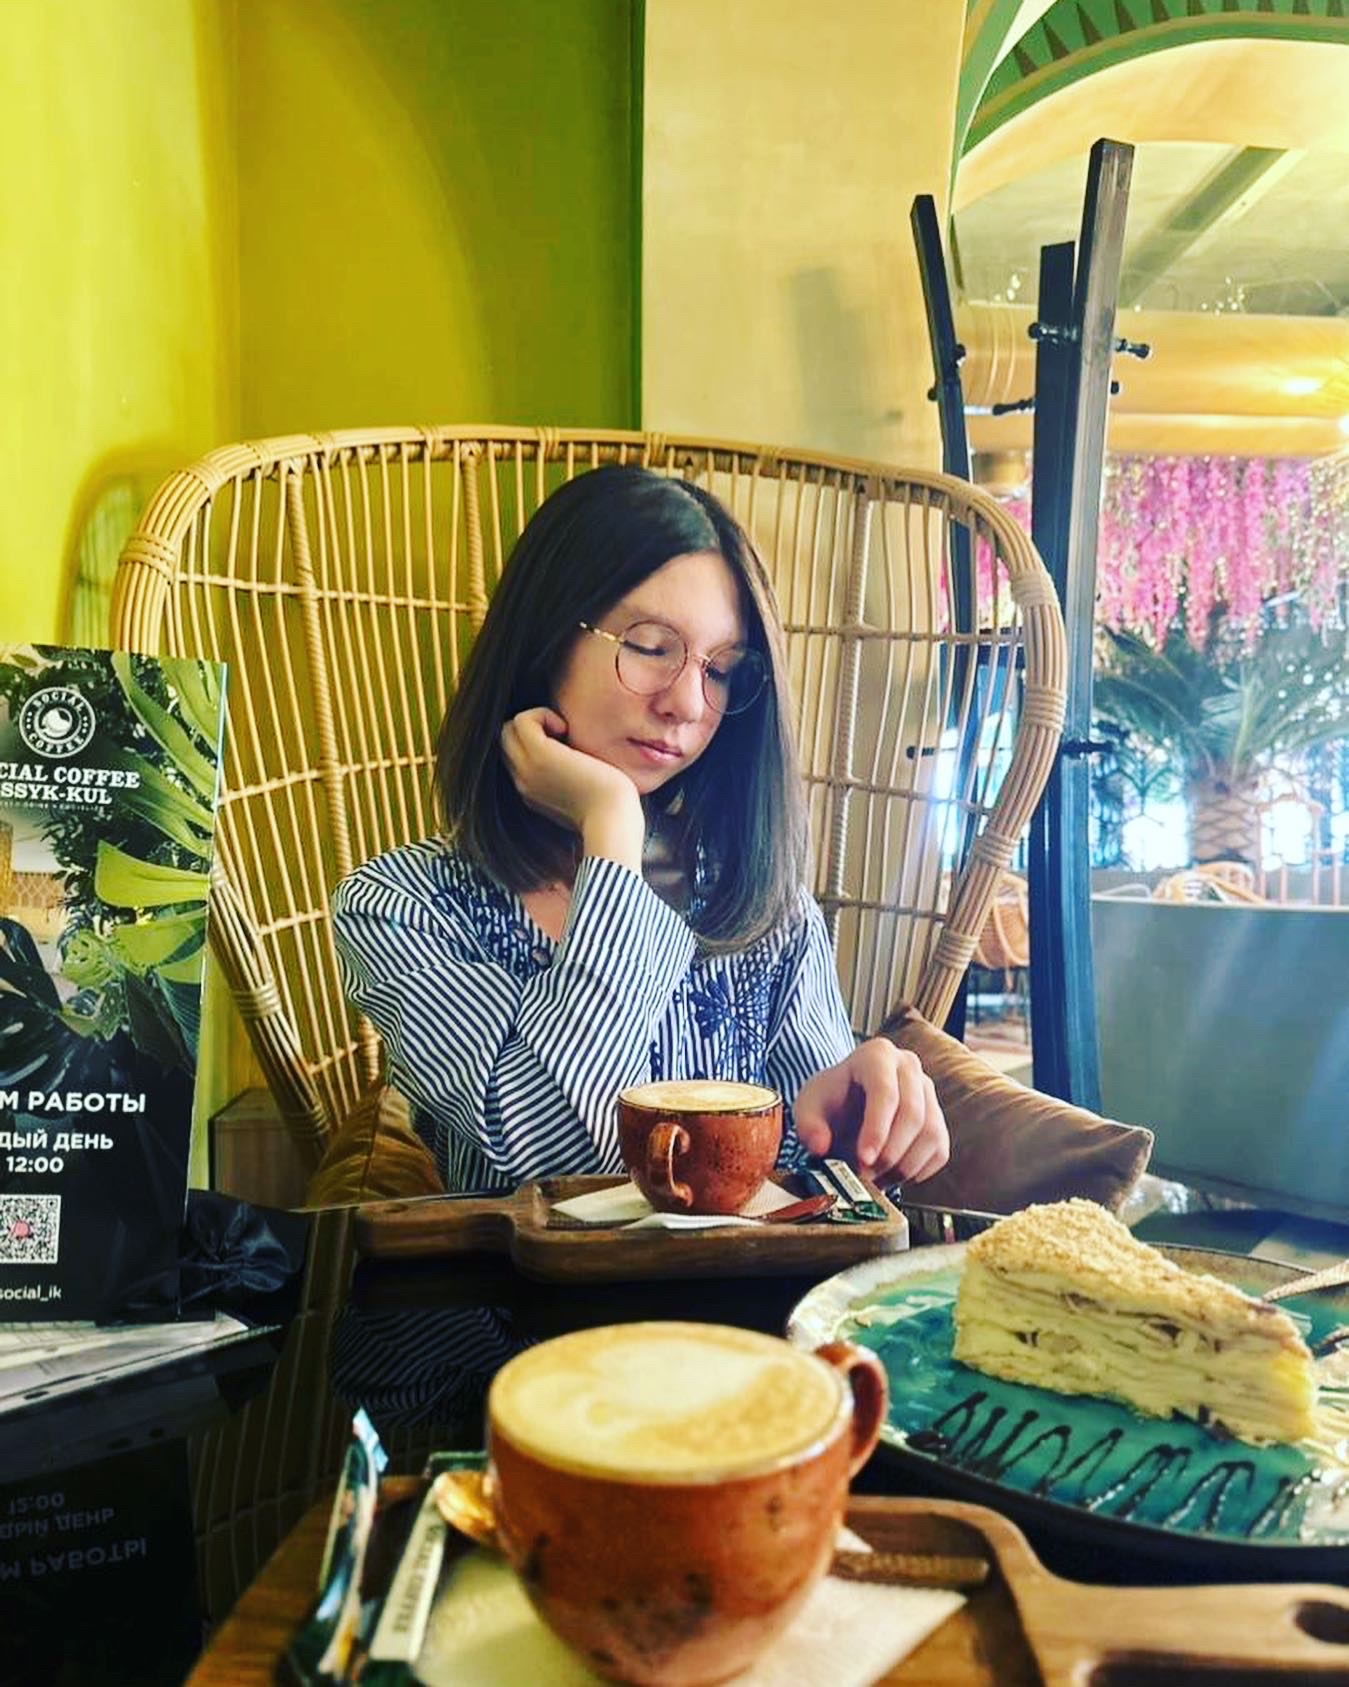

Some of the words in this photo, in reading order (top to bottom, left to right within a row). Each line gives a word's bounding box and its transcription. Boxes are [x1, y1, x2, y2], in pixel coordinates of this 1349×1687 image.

[32, 691, 86, 713] SOCIAL
[28, 732, 85, 755] COFFEE
[53, 766, 141, 789] COFFEE
[0, 782, 113, 804] SSYK-KUL
[28, 1092, 146, 1113] РАБОТЫ
[53, 1133, 114, 1152] ДЕНЬ
[6, 1156, 65, 1173] 12:00
